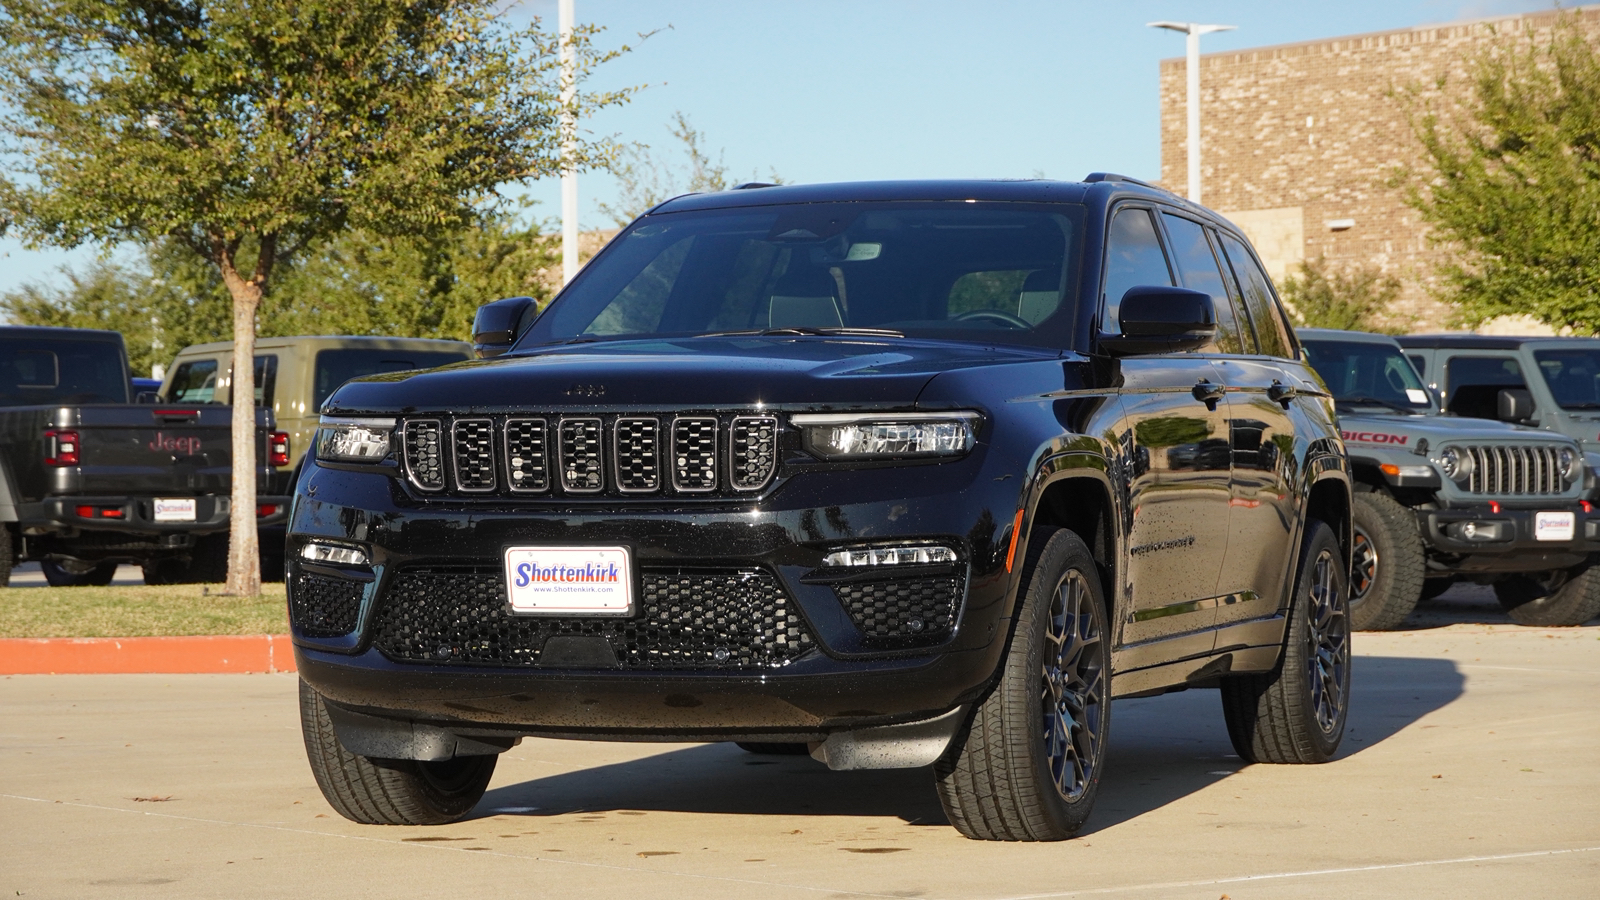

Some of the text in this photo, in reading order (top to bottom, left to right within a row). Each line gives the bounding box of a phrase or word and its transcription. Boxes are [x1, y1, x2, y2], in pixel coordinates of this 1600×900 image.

[148, 431, 202, 456] Jeep
[1341, 431, 1408, 445] BICON
[515, 562, 619, 588] Shottenkirk
